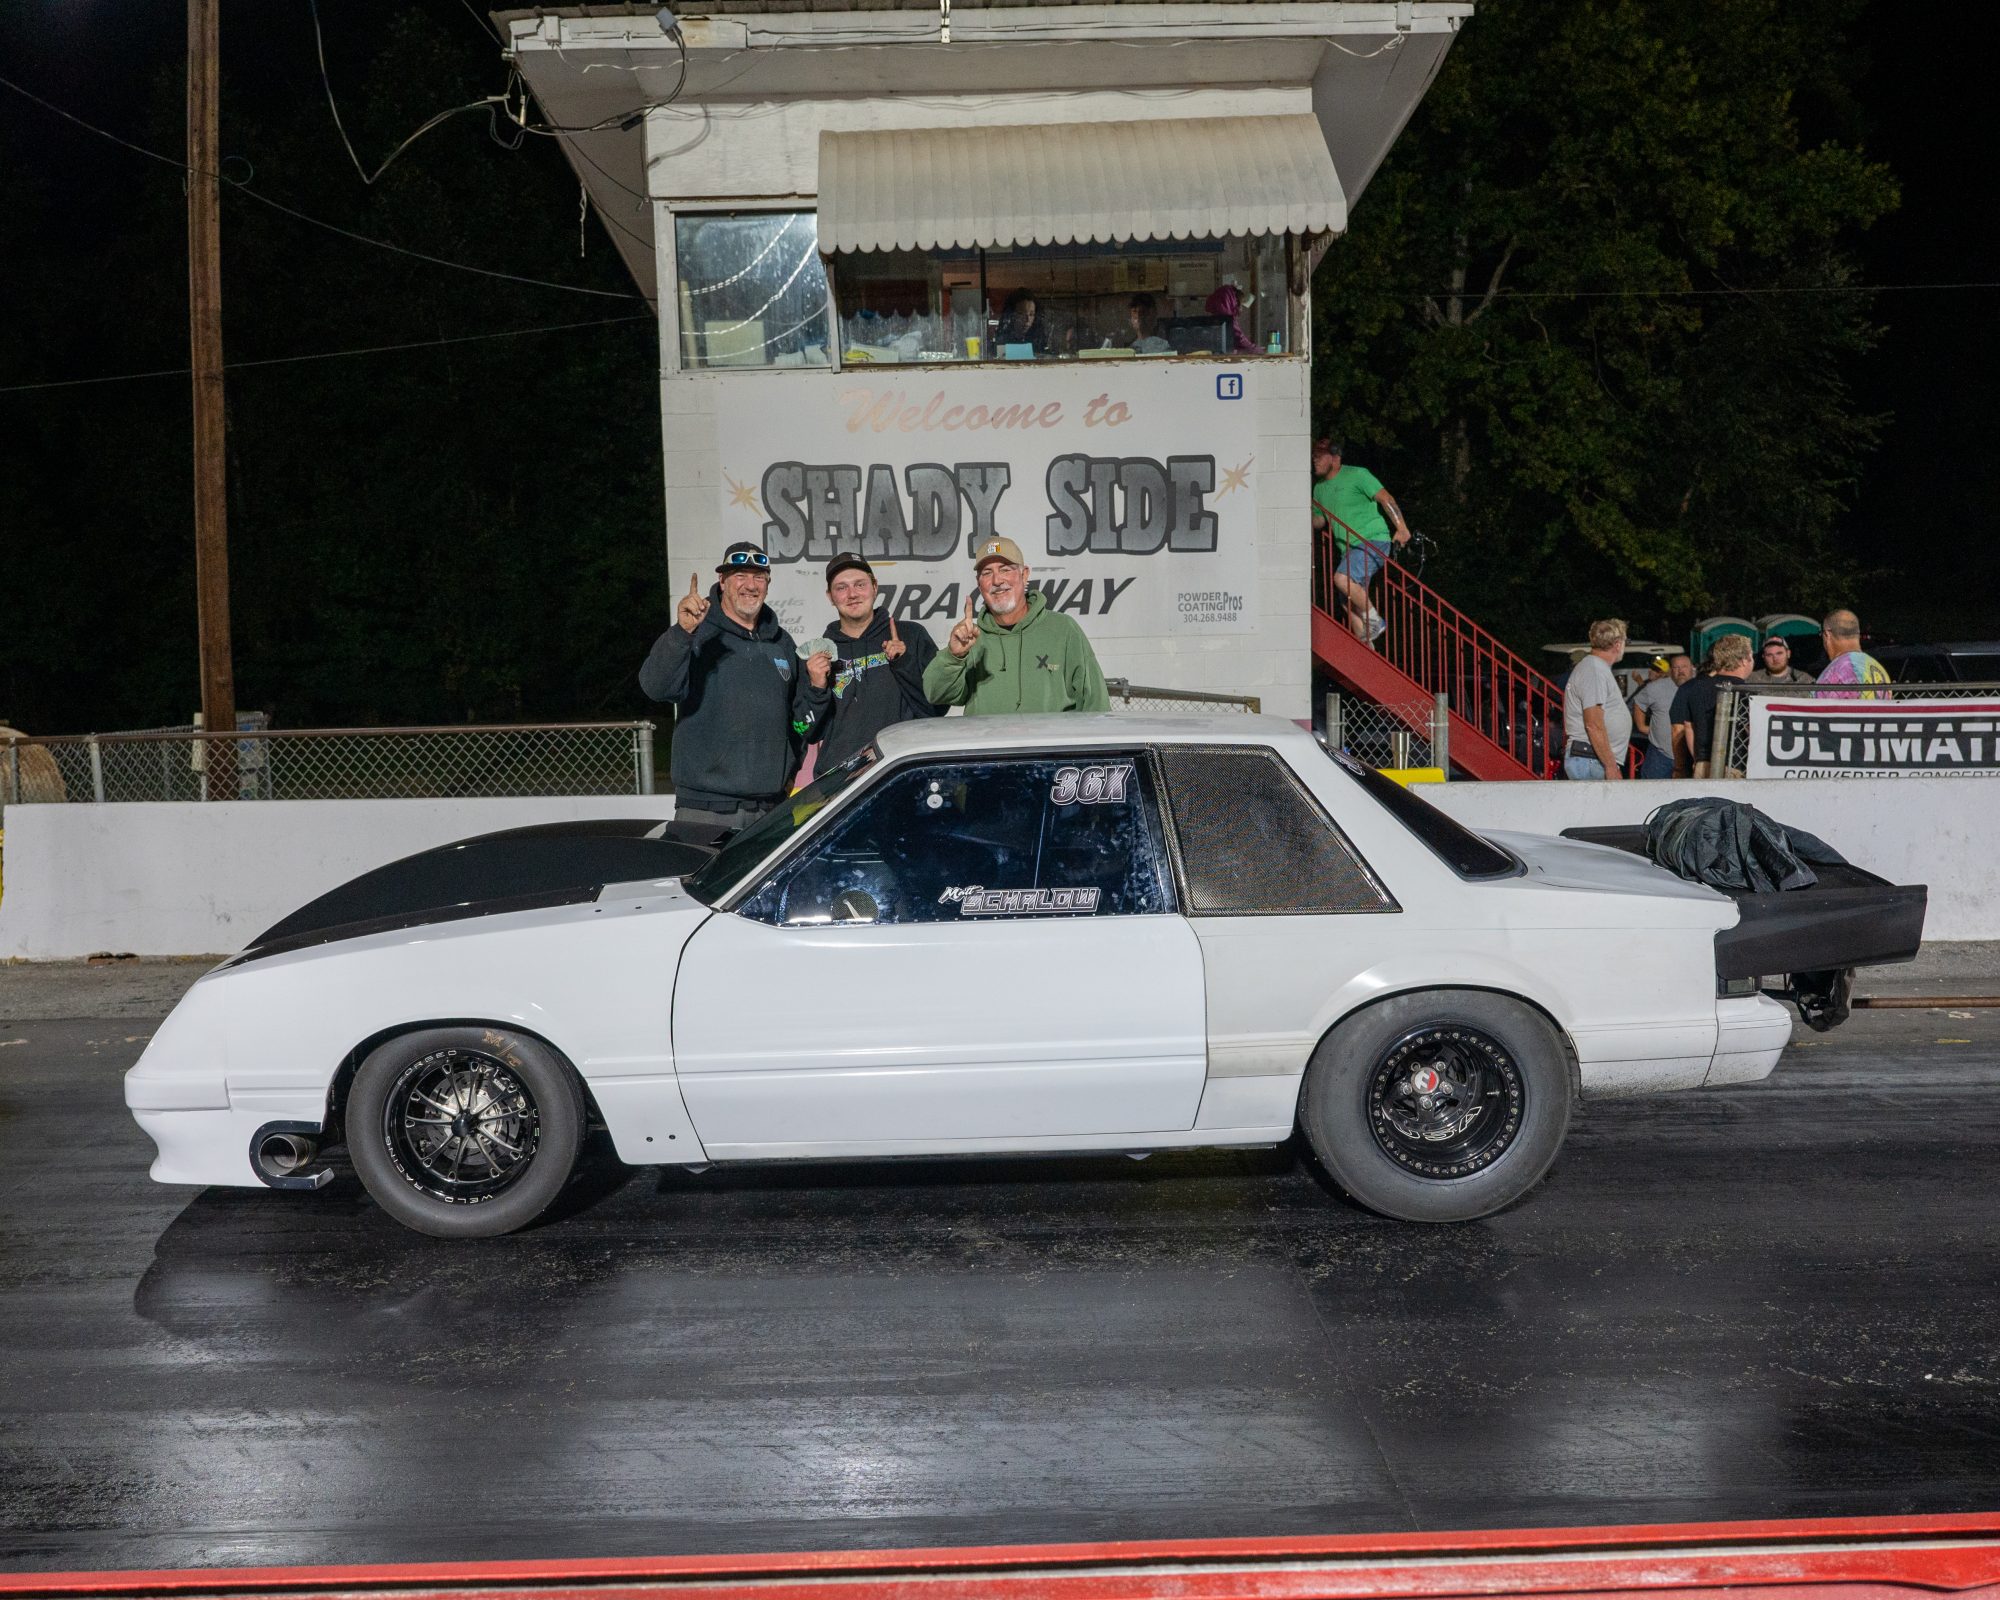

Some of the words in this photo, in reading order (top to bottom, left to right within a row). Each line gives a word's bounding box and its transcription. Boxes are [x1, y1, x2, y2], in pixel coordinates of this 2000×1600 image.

[838, 389, 1065, 433] Welcome
[1083, 393, 1132, 428] to
[761, 460, 1011, 564] SHADY
[1046, 453, 1219, 556] SIDE
[1177, 592, 1222, 602] POWDER
[1222, 592, 1243, 611] Pros
[1177, 601, 1223, 612] COATING
[1770, 720, 2000, 763] ULTIMAT
[1050, 765, 1133, 806] 36X
[960, 887, 1101, 915] SCHALOW
[397, 1050, 457, 1086] FORGED
[384, 1135, 424, 1191] RACING
[444, 1194, 494, 1204] WELD
